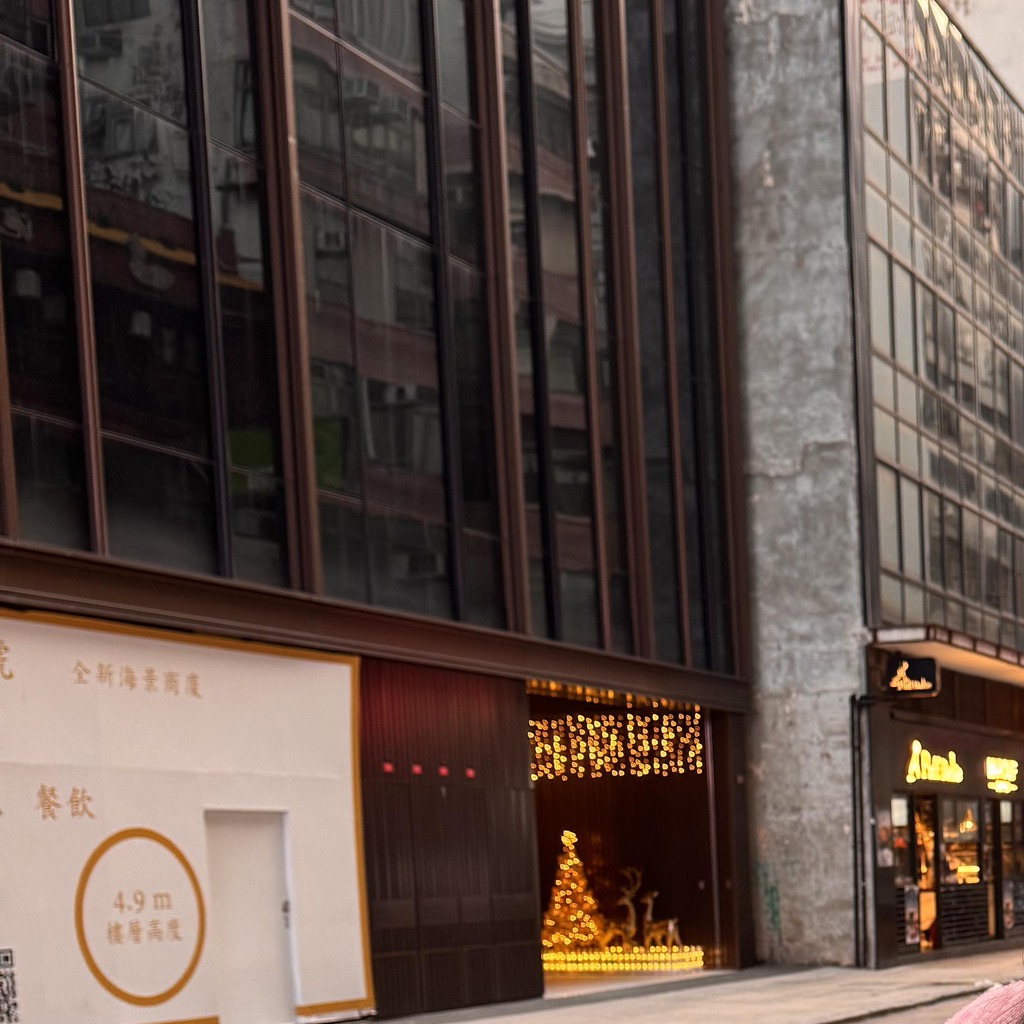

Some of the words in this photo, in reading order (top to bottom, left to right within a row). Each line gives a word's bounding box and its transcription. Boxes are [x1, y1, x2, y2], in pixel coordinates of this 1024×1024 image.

[36, 783, 96, 821] 餐飲
[113, 889, 145, 914] 4.9
[152, 891, 173, 911] m
[107, 918, 185, 945] 樓層高度
